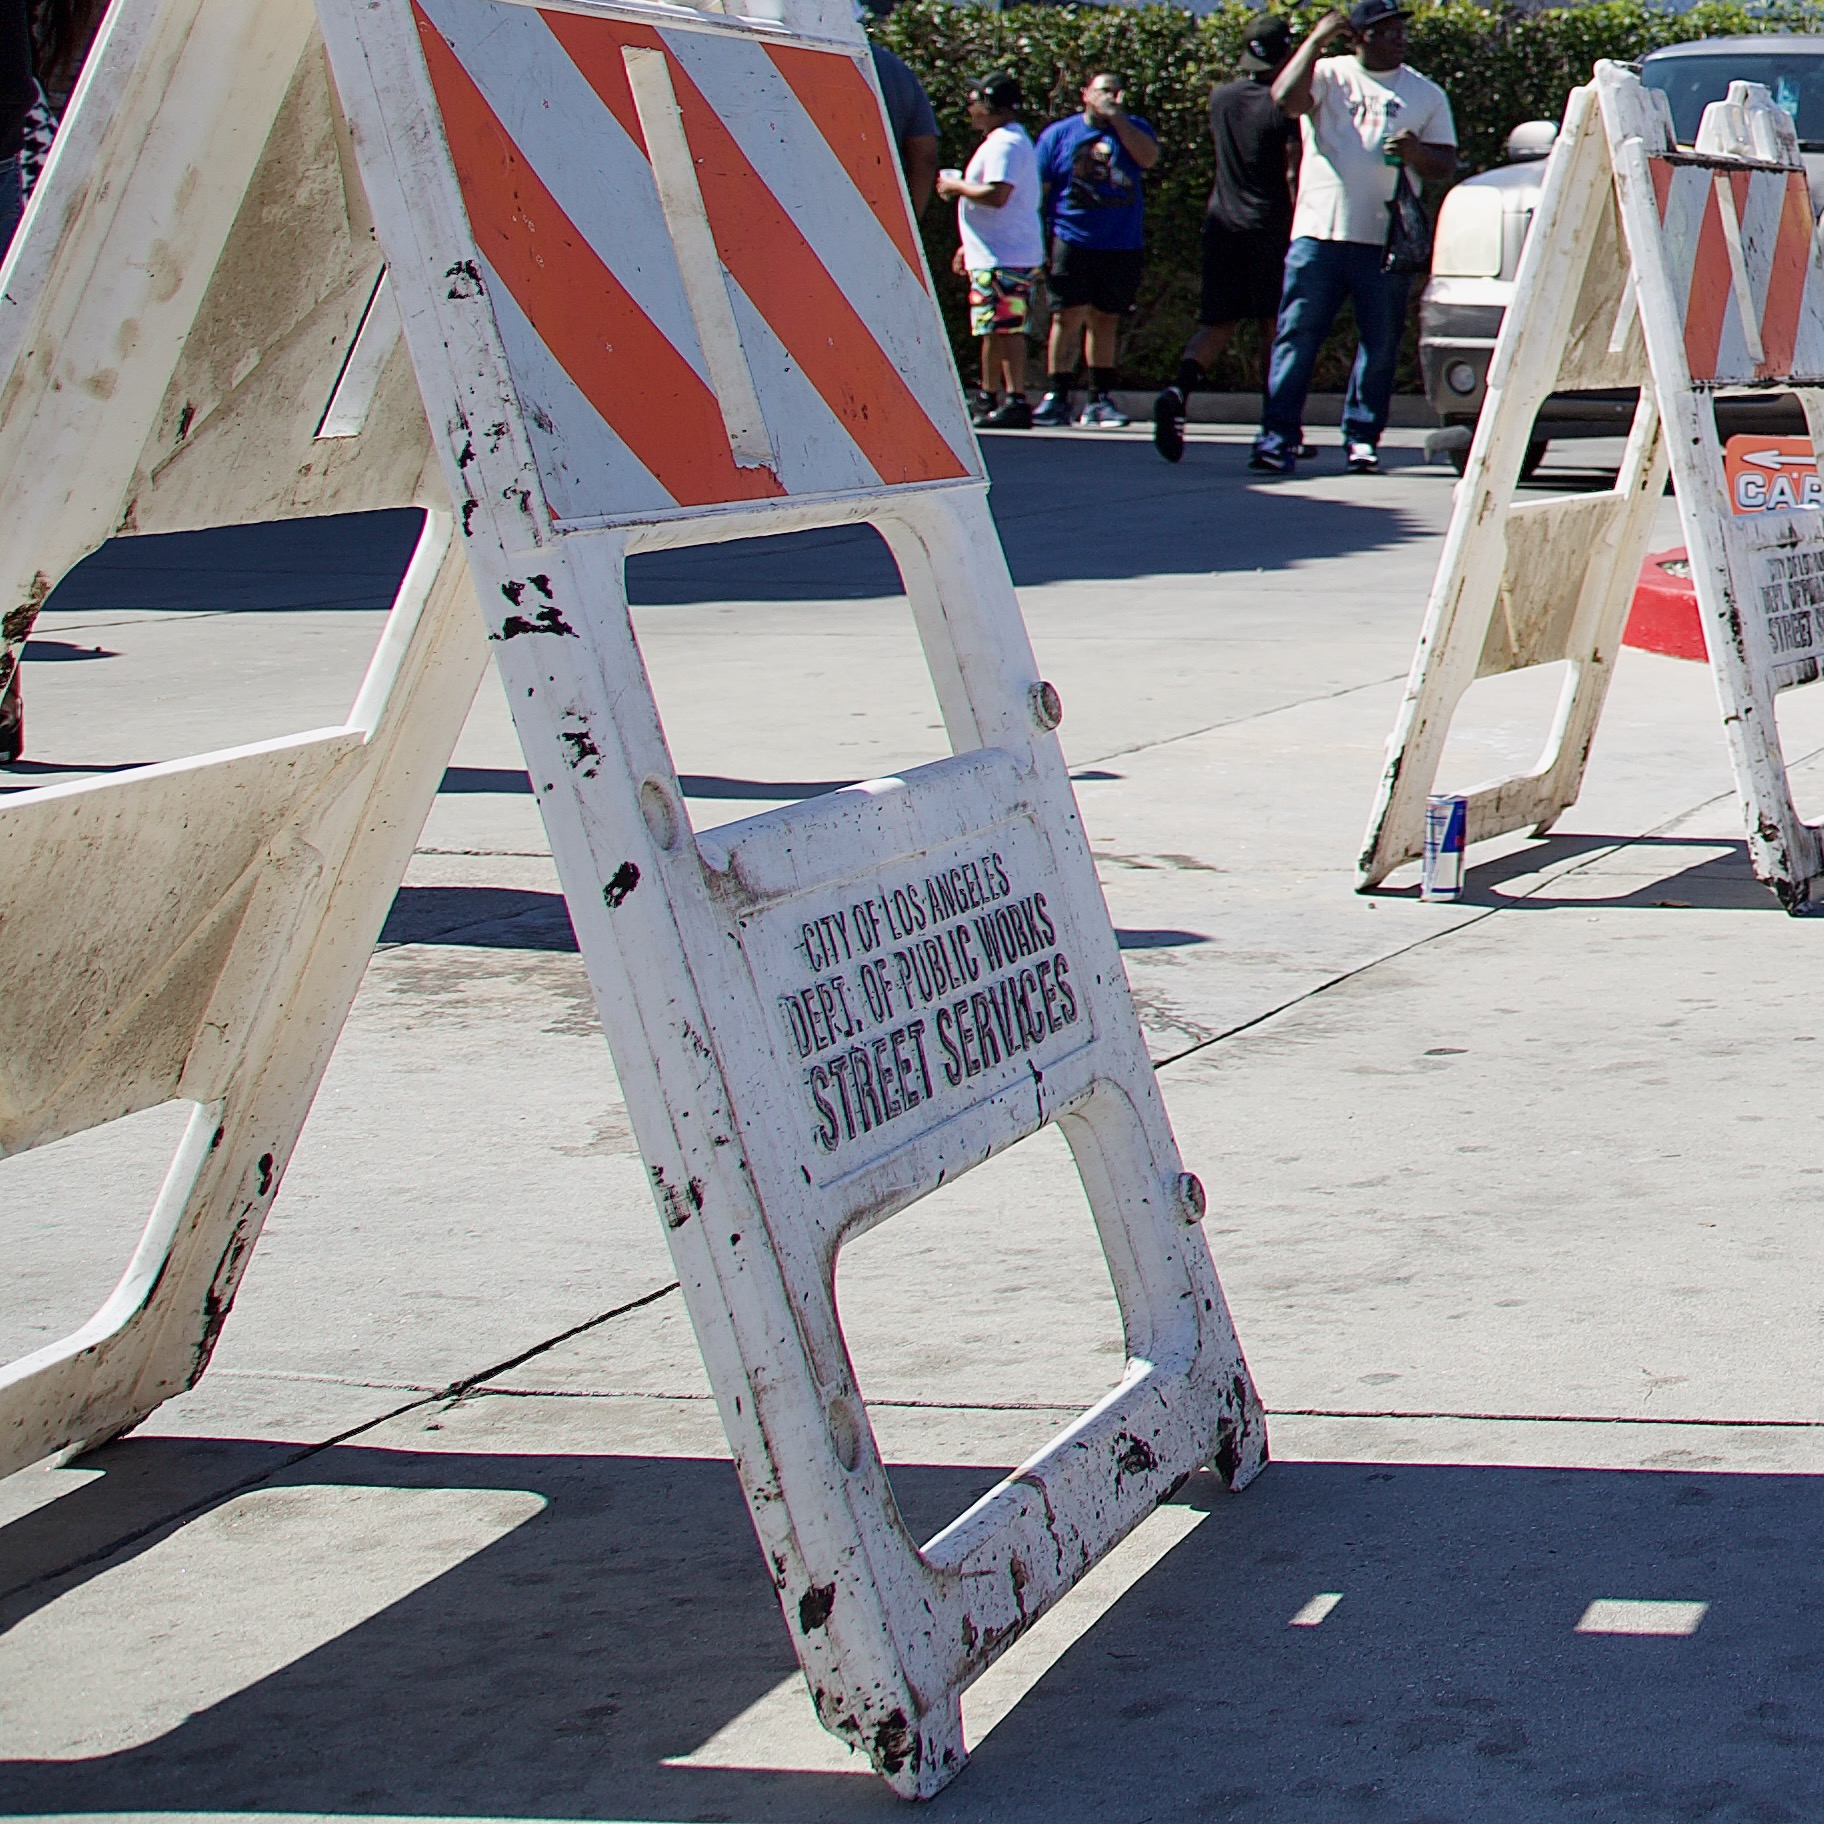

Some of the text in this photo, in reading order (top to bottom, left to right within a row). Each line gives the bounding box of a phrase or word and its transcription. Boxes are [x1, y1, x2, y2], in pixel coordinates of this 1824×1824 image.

[1768, 610, 1813, 654] STREET
[784, 892, 1057, 1059] DEPT. OF PUBLIC WORKS
[803, 852, 1012, 973] CITY OF LOS ANGELES
[811, 952, 1079, 1152] STREET SERVICES
